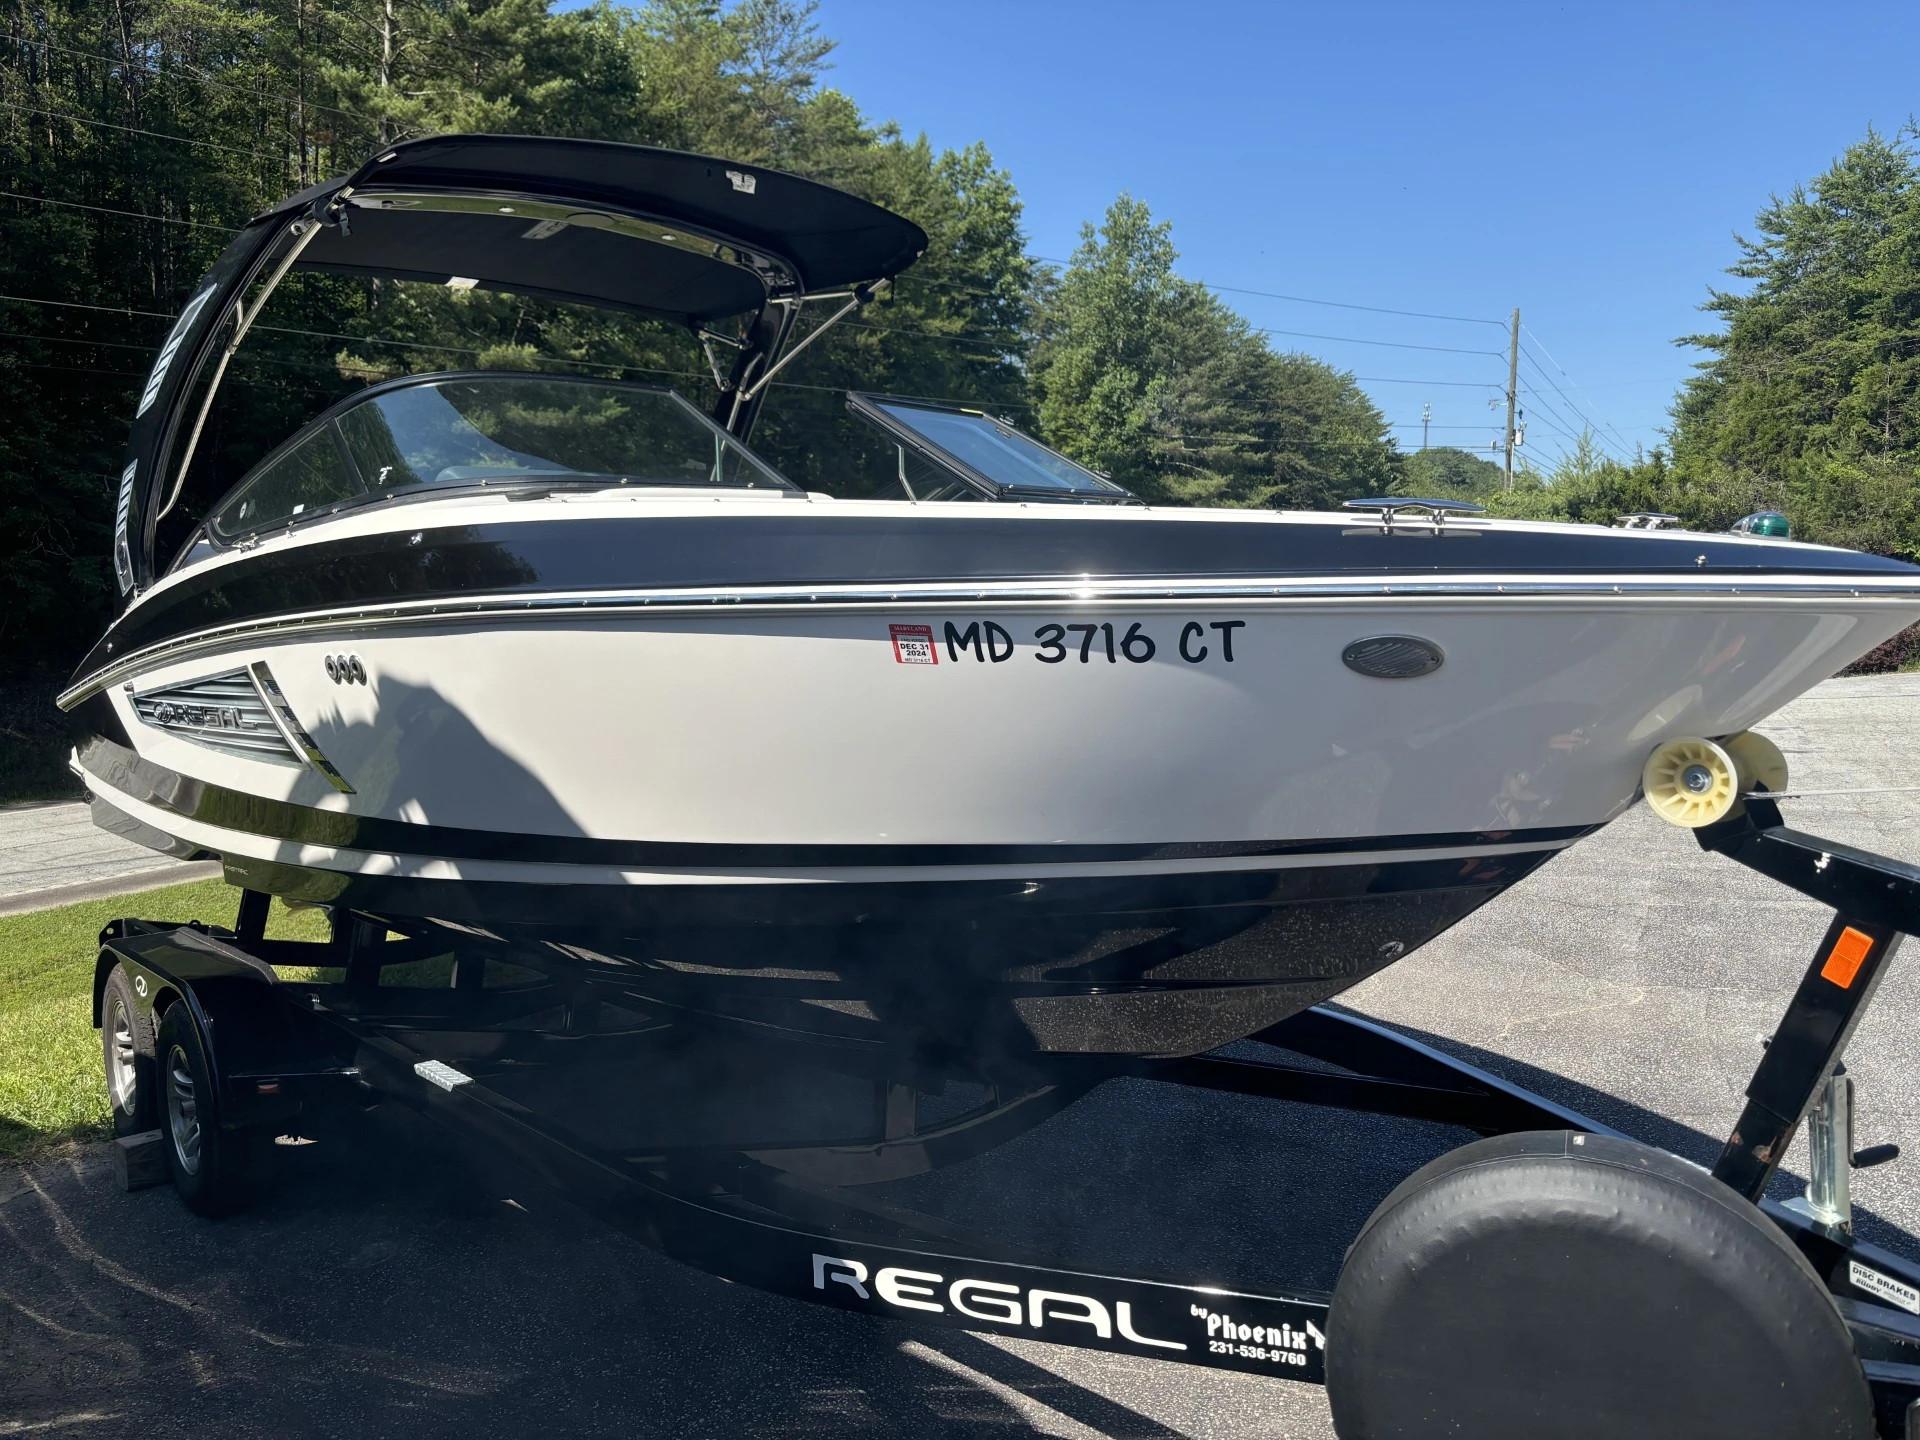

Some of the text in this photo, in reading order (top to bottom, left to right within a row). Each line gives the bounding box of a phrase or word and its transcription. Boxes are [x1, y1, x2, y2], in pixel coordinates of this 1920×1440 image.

[944, 620, 1247, 664] MD 3716 CT
[173, 702, 259, 731] REGAL
[1852, 1266, 1875, 1281] DISC
[1876, 1277, 1916, 1301] BRAKES
[812, 1253, 1188, 1351] REGAL
[1190, 1303, 1208, 1319] by
[1206, 1312, 1307, 1350] Phoenix
[1208, 1340, 1306, 1366] 231-536-9760
